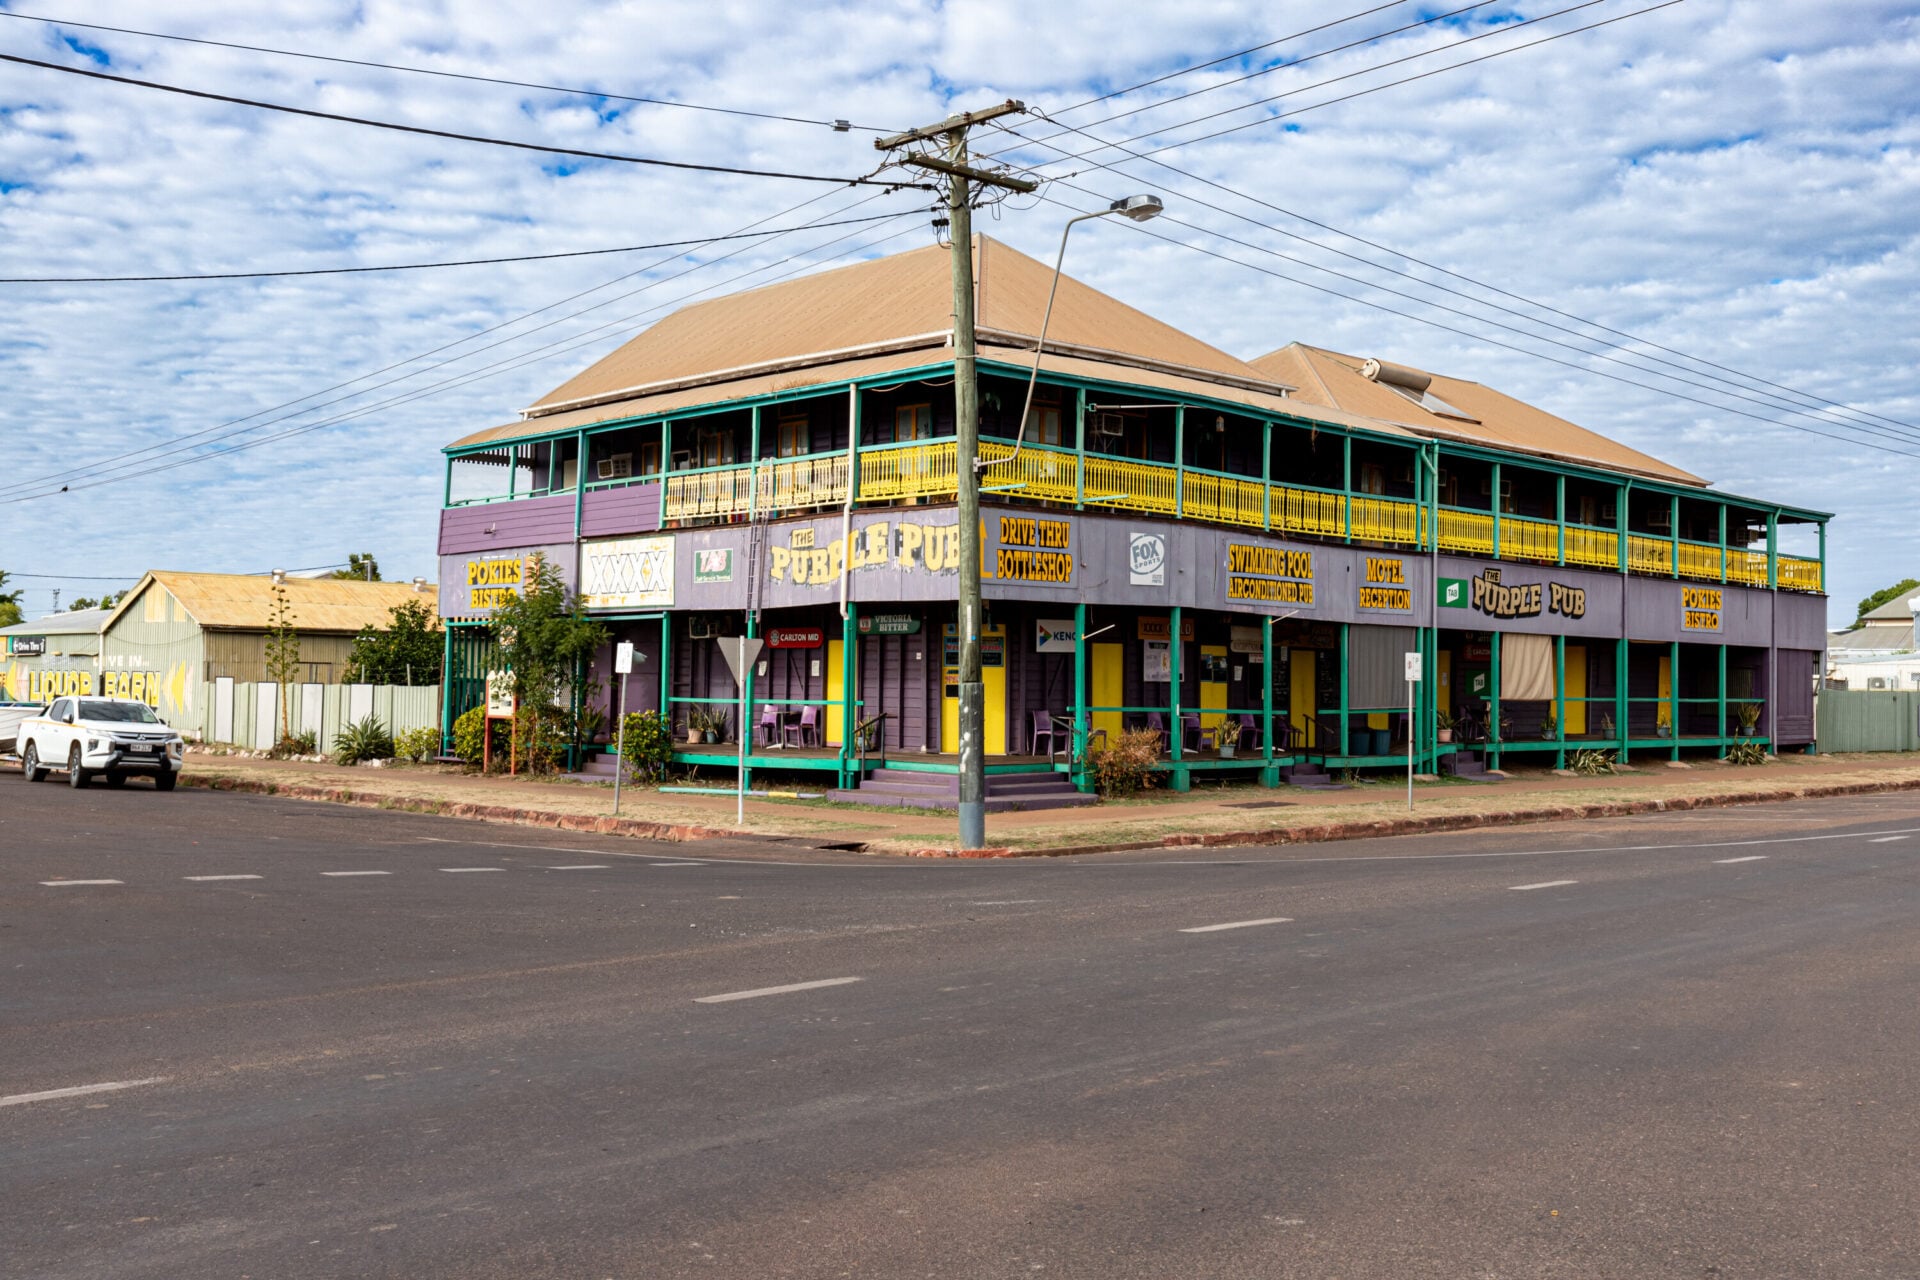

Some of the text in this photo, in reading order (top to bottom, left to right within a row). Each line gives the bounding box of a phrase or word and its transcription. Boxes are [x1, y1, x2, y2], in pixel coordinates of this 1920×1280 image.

[794, 530, 813, 546] THE
[1000, 516, 1070, 548] DRIVE THRU
[770, 521, 889, 585] PURPLE
[1132, 540, 1160, 563] FOX
[1134, 556, 1161, 569] SPORTS
[1228, 543, 1313, 580] SWIMMING POOL
[467, 559, 522, 585] POKIES
[589, 551, 667, 595] XXXX
[997, 549, 1073, 583] BOTTLESHOP
[1366, 556, 1405, 584] MOTEL
[1486, 571, 1499, 582] THE
[1228, 577, 1314, 605] AIRCONDITIONED PUB
[1359, 587, 1411, 610] RECEPTION
[1473, 576, 1586, 618] PURPLE PUB
[1682, 586, 1723, 610] POKIES
[874, 614, 912, 623] VICTORIA
[879, 623, 908, 632] BITTER
[1685, 611, 1719, 630] BISTRO
[19, 642, 29, 651] Drive
[780, 633, 819, 642] CARLTON MID
[29, 669, 93, 704] LIQUOR
[104, 671, 160, 707] BARN
